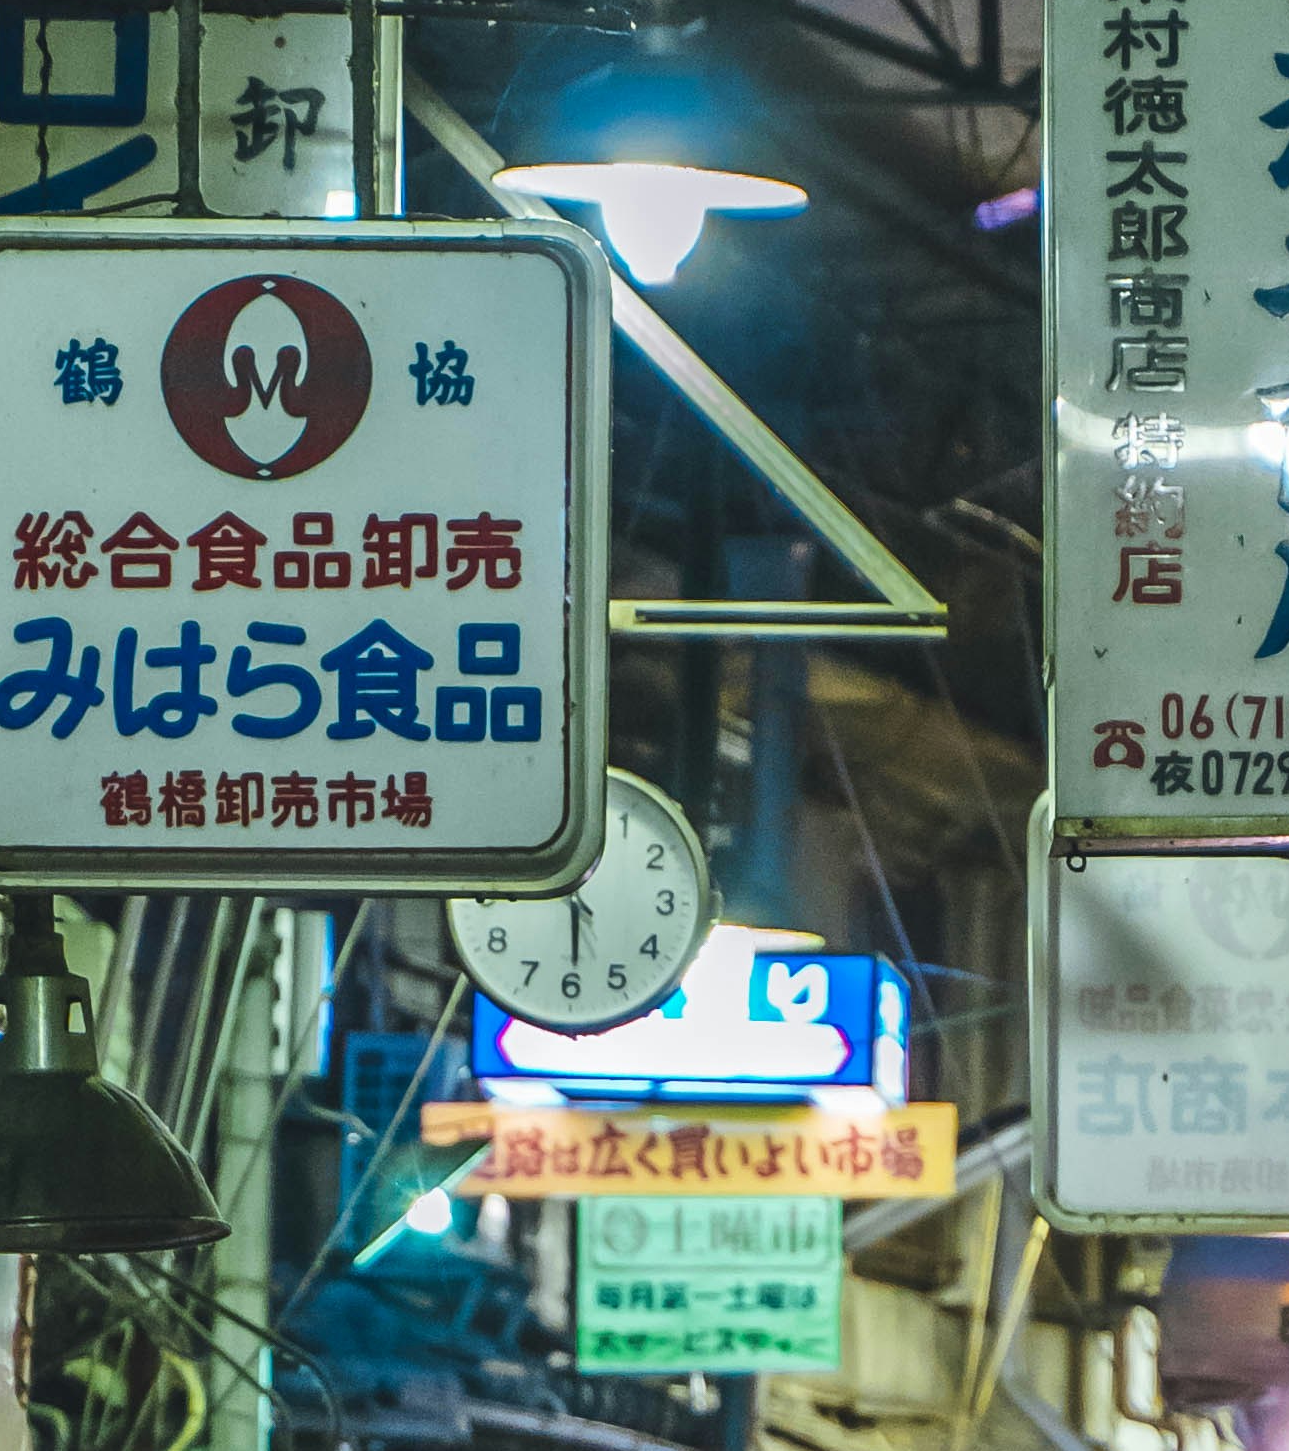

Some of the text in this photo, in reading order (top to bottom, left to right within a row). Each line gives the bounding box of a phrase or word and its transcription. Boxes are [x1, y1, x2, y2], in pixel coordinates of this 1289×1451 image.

[54, 338, 475, 407] 鶴 協
[13, 511, 523, 591] 総合食品卸売
[99, 770, 433, 828] 鶴橋卸売市場
[619, 812, 629, 839] 1
[646, 844, 665, 870] 2
[656, 890, 675, 915] 3
[487, 927, 507, 953] 8
[639, 934, 659, 960] 4
[520, 961, 540, 987] 7
[561, 973, 581, 998] 6
[607, 964, 627, 990] 5
